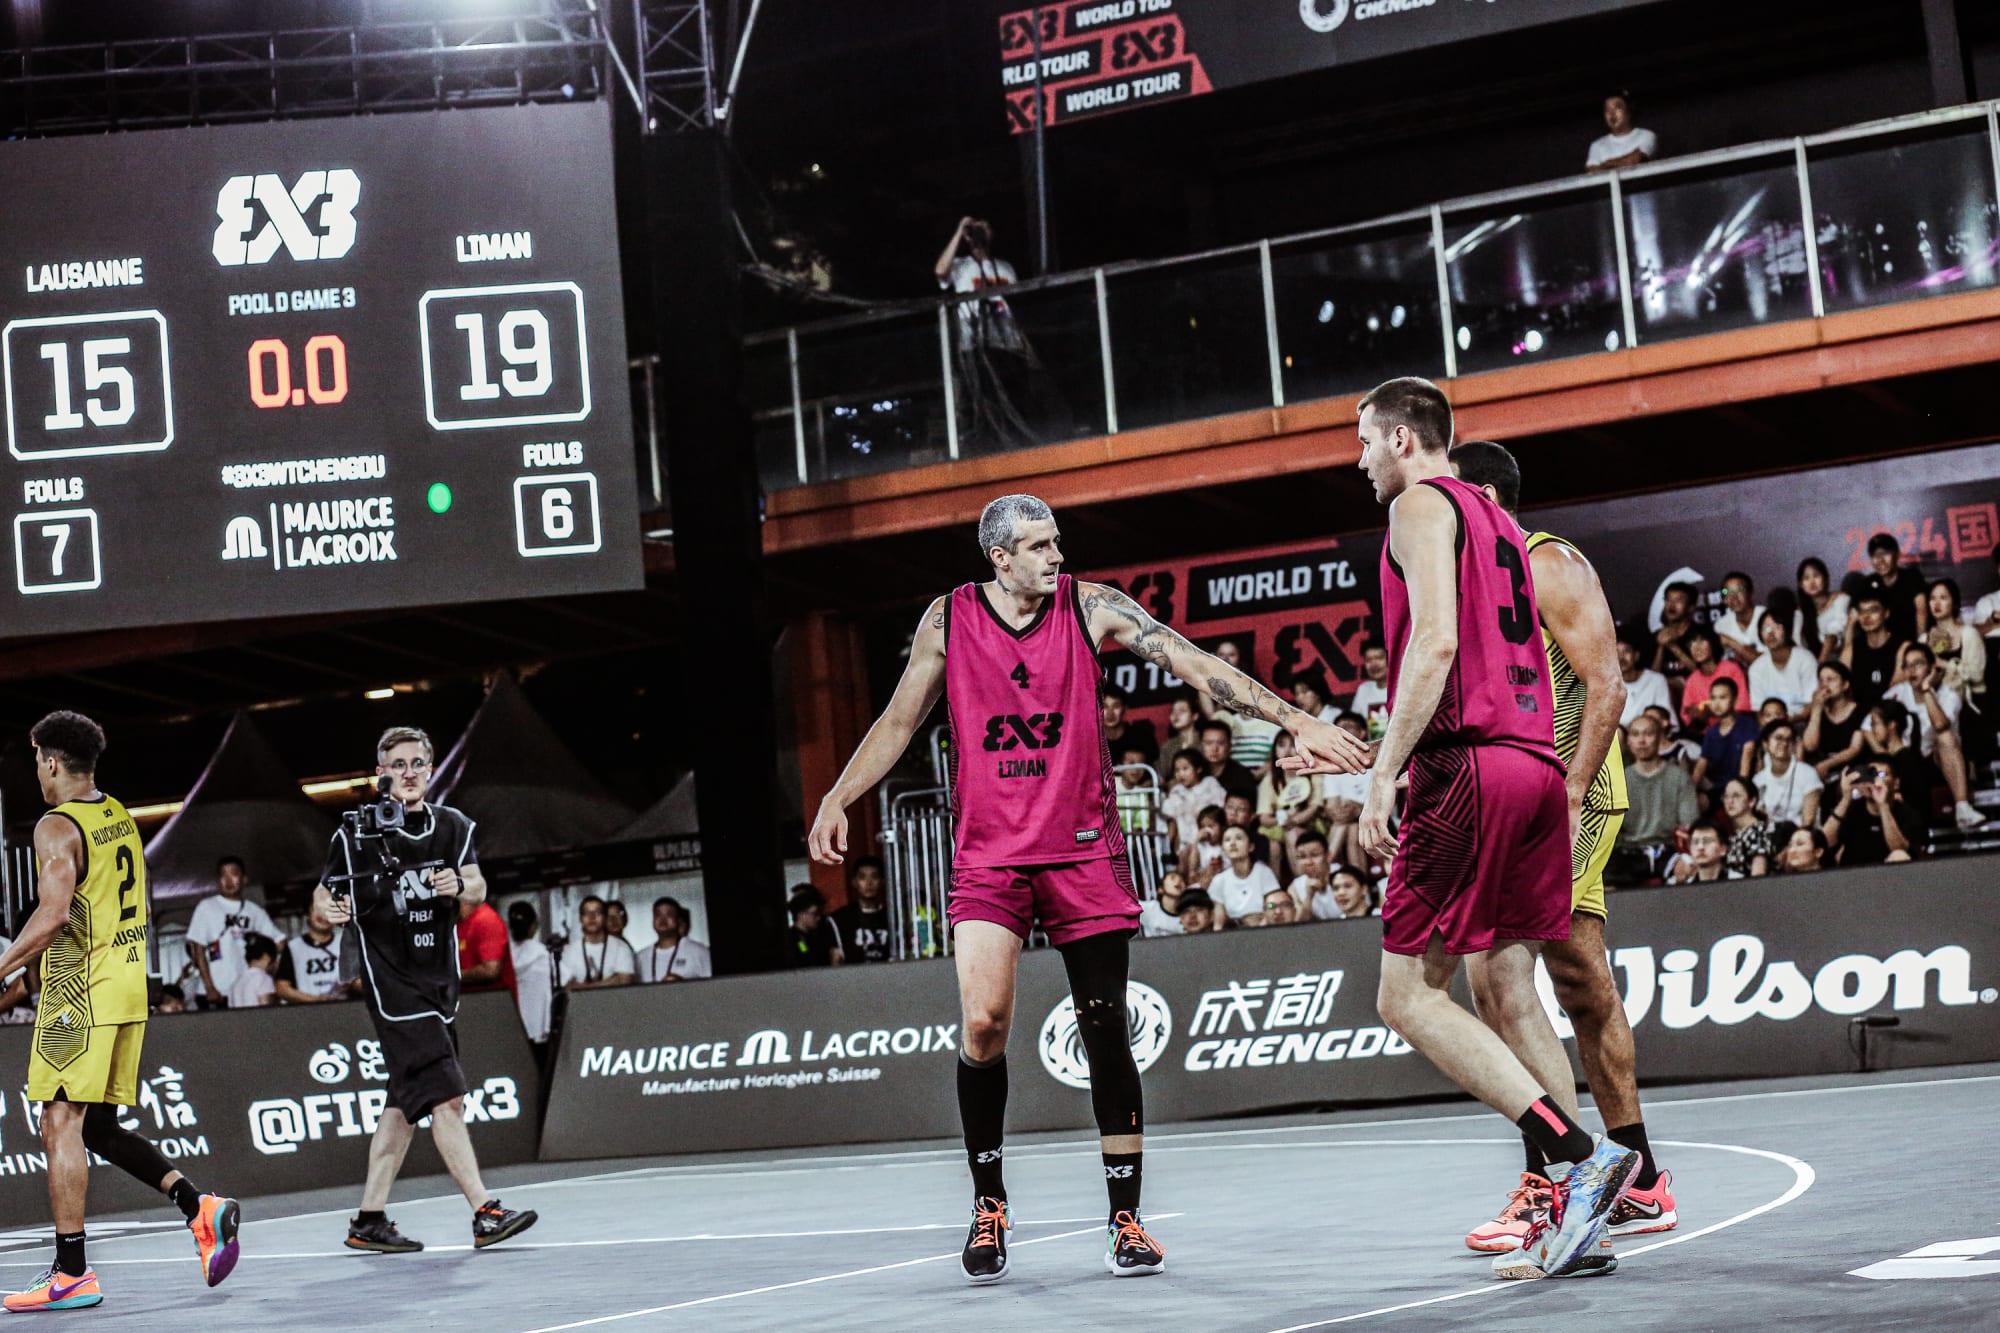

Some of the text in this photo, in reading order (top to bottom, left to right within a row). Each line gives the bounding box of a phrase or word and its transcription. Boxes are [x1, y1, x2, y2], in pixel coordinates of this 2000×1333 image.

[1075, 0, 1136, 27] WORLD
[1002, 50, 1090, 85] RLD TOUR
[1066, 72, 1181, 113] WORLD TOUR
[456, 231, 532, 263] LIMAN
[26, 257, 144, 292] LAUSANNE
[229, 286, 357, 316] POOL D GAME 3
[248, 334, 348, 409] 0.0
[455, 309, 552, 401] 19
[40, 337, 136, 430] 15
[523, 441, 584, 468] FOULS
[24, 476, 85, 505] FOULS
[283, 496, 395, 535] MAURICE
[541, 487, 575, 540] 6
[41, 523, 71, 577] 7
[285, 530, 398, 568] LACROIX
[1207, 565, 1312, 607] WORLD
[1318, 560, 1357, 590] TO
[1495, 535, 1535, 646] 3
[1010, 661, 1030, 689] 4
[998, 759, 1047, 779] LIMAN
[116, 844, 137, 922] 2
[409, 909, 434, 923] FIBA
[413, 932, 436, 948] 002
[1188, 969, 1345, 1037] 成都
[580, 1041, 730, 1079] MAURICE
[800, 1023, 959, 1063] LACROIX
[642, 1065, 881, 1096] Manufacture Horlogère Suisse
